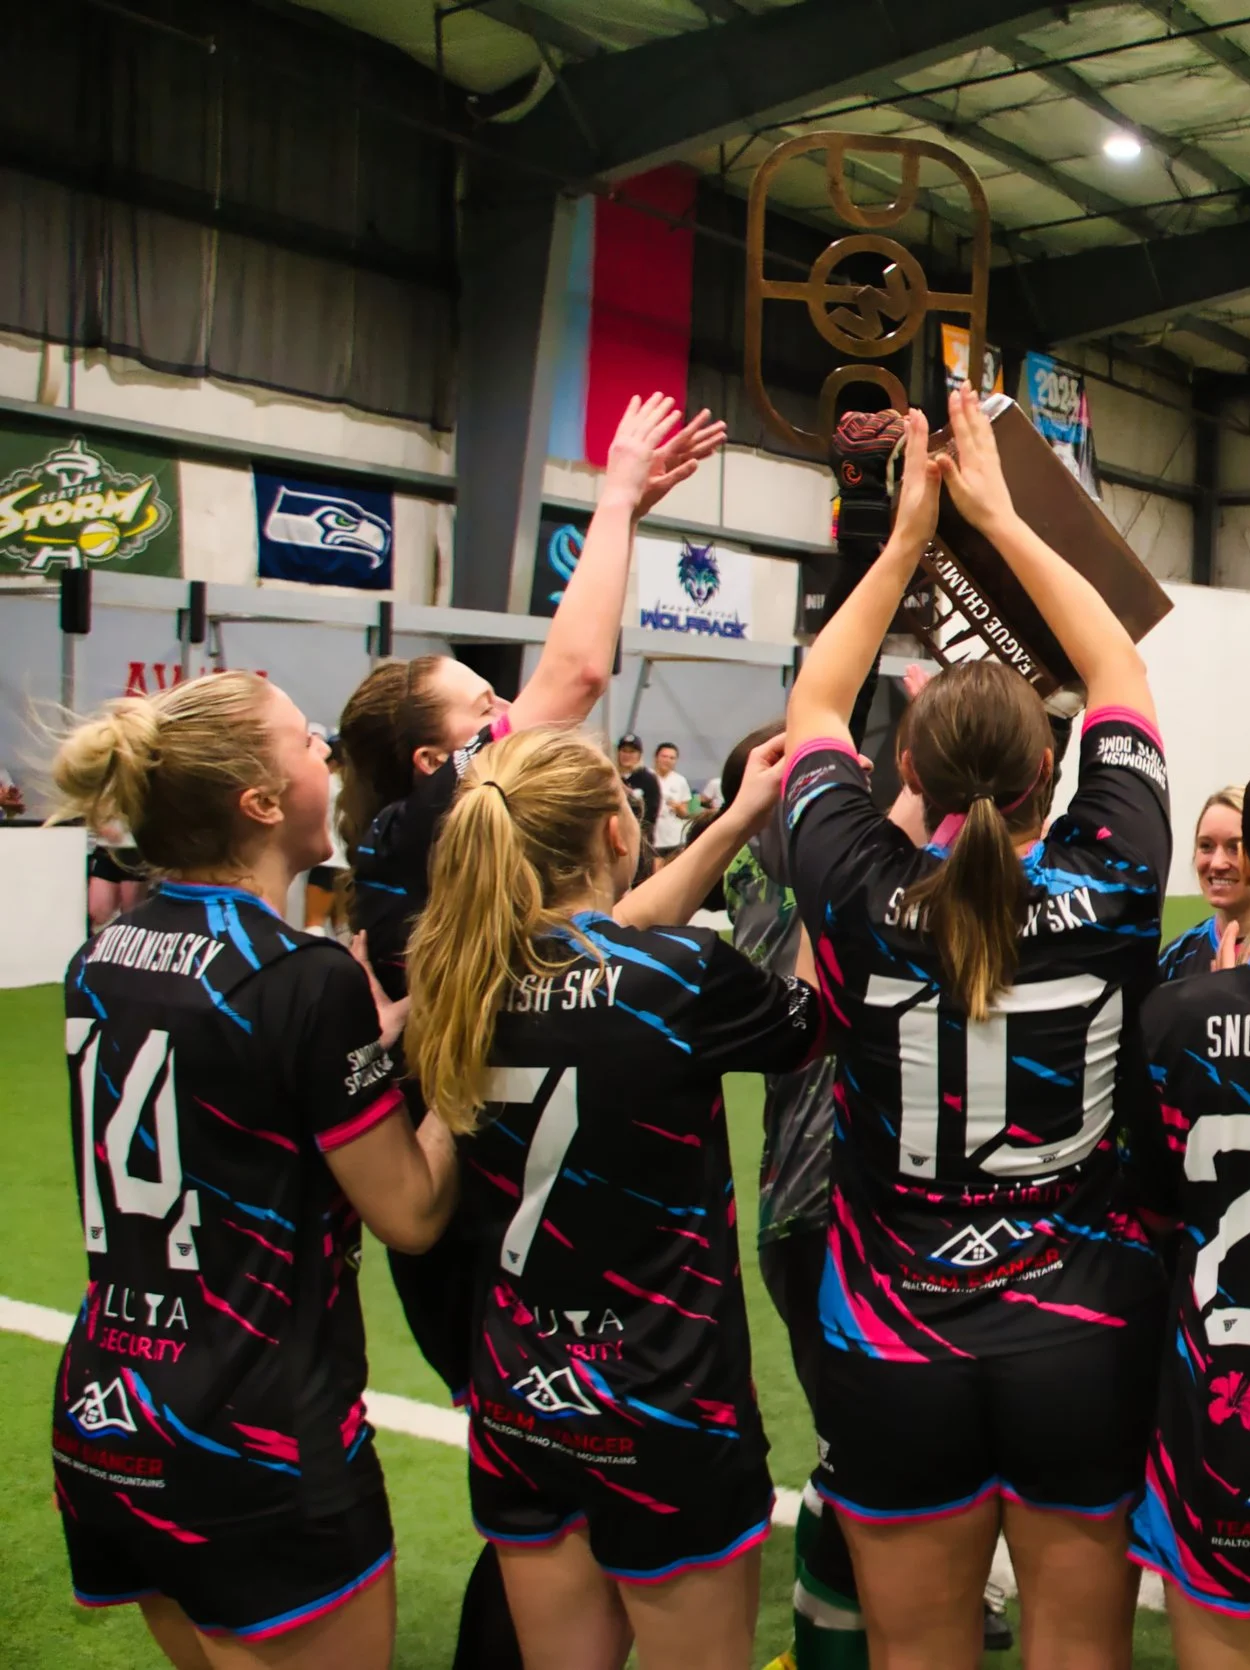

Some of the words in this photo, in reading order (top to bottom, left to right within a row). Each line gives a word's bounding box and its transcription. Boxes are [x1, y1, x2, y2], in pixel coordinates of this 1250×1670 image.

[0, 481, 153, 539] STORM
[39, 482, 103, 504] SEATTLE
[640, 603, 750, 640] WOLFPACK
[1097, 736, 1132, 756] DOME
[1046, 886, 1097, 933] SKY
[171, 933, 225, 979] SKY
[562, 965, 623, 1010] SKY
[864, 973, 1124, 1179] 10
[65, 1017, 201, 1271] 14
[483, 1067, 579, 1278] 7
[534, 1305, 624, 1337] UTA
[99, 1327, 187, 1363] SECURITY
[566, 1340, 624, 1361] RITY
[485, 1401, 535, 1431] TEAM
[483, 1416, 524, 1438] REALTORS
[525, 1434, 550, 1447] WHO
[577, 1452, 637, 1465] MOUNTAINS
[109, 1473, 166, 1488] MOUNTAINS
